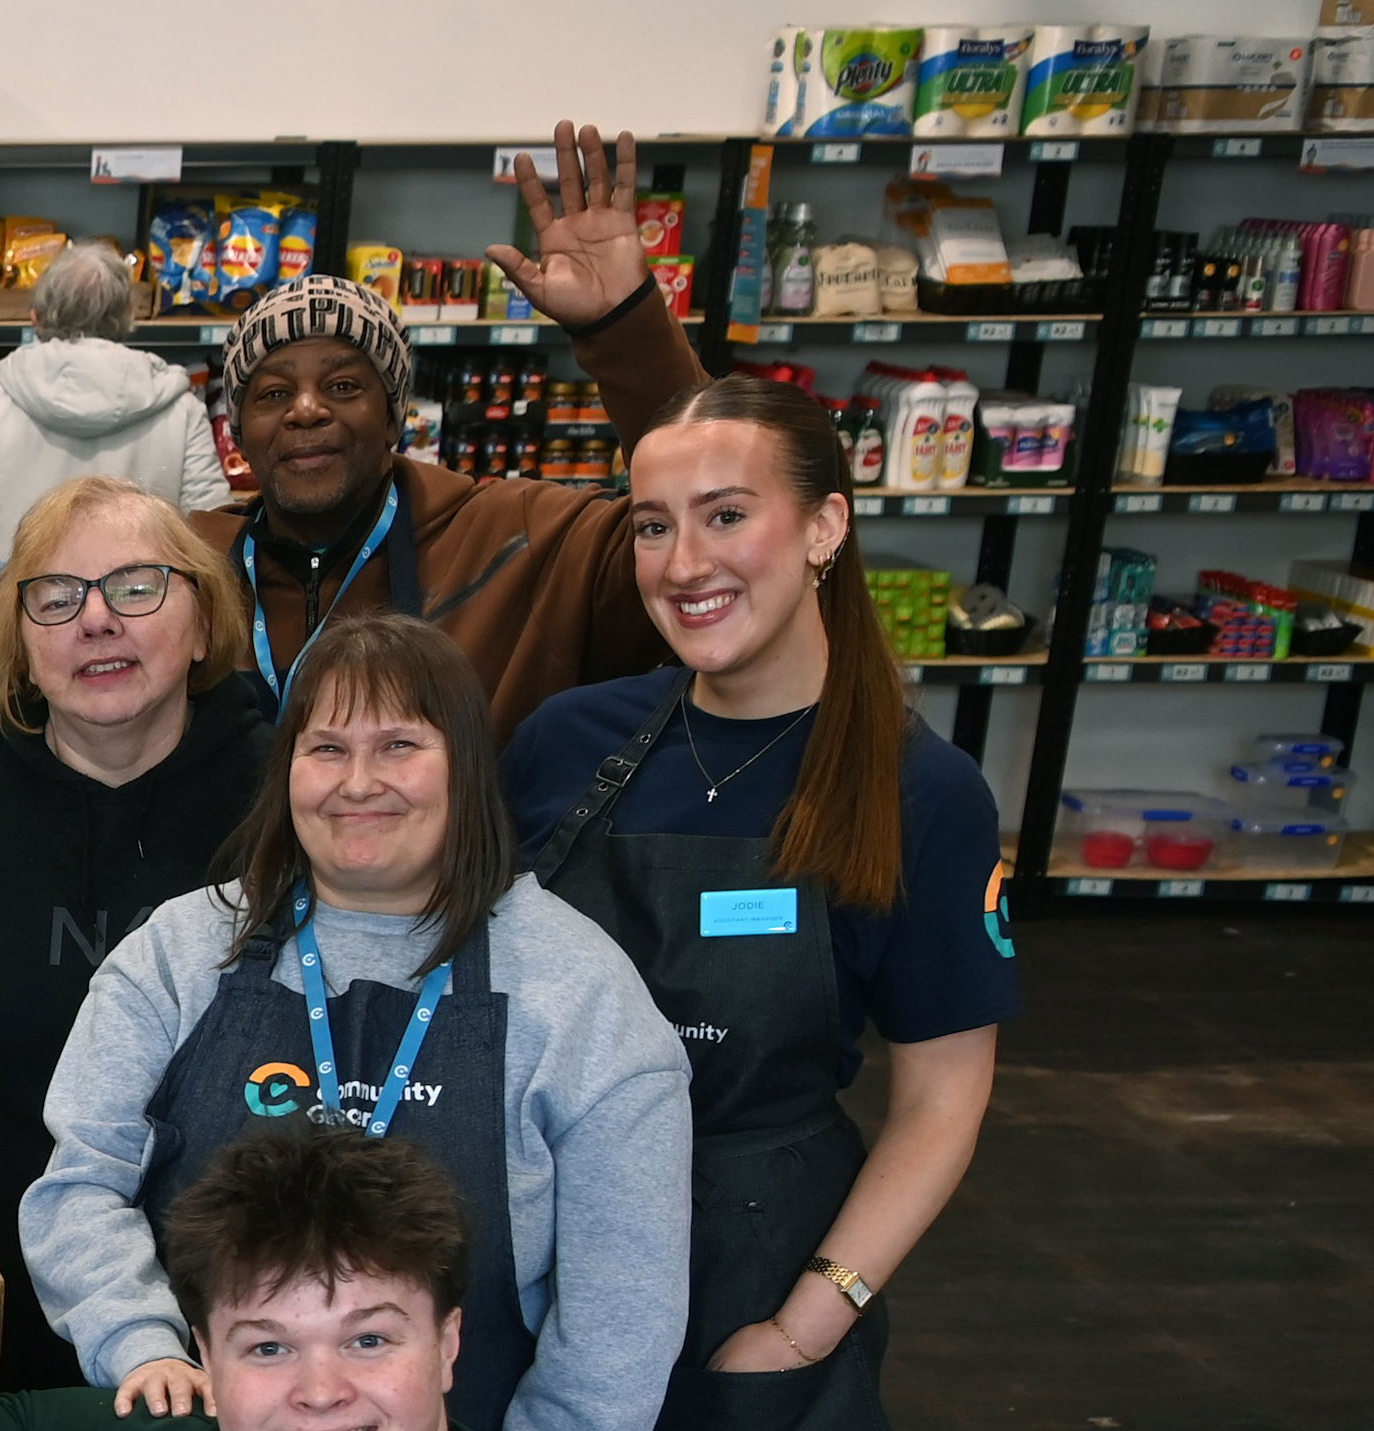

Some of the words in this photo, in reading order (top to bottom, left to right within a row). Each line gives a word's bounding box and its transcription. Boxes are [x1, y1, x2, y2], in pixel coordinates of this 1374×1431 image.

[835, 58, 893, 95] Plenty
[947, 67, 1007, 94] ULTRA
[731, 901, 765, 912] JODIE
